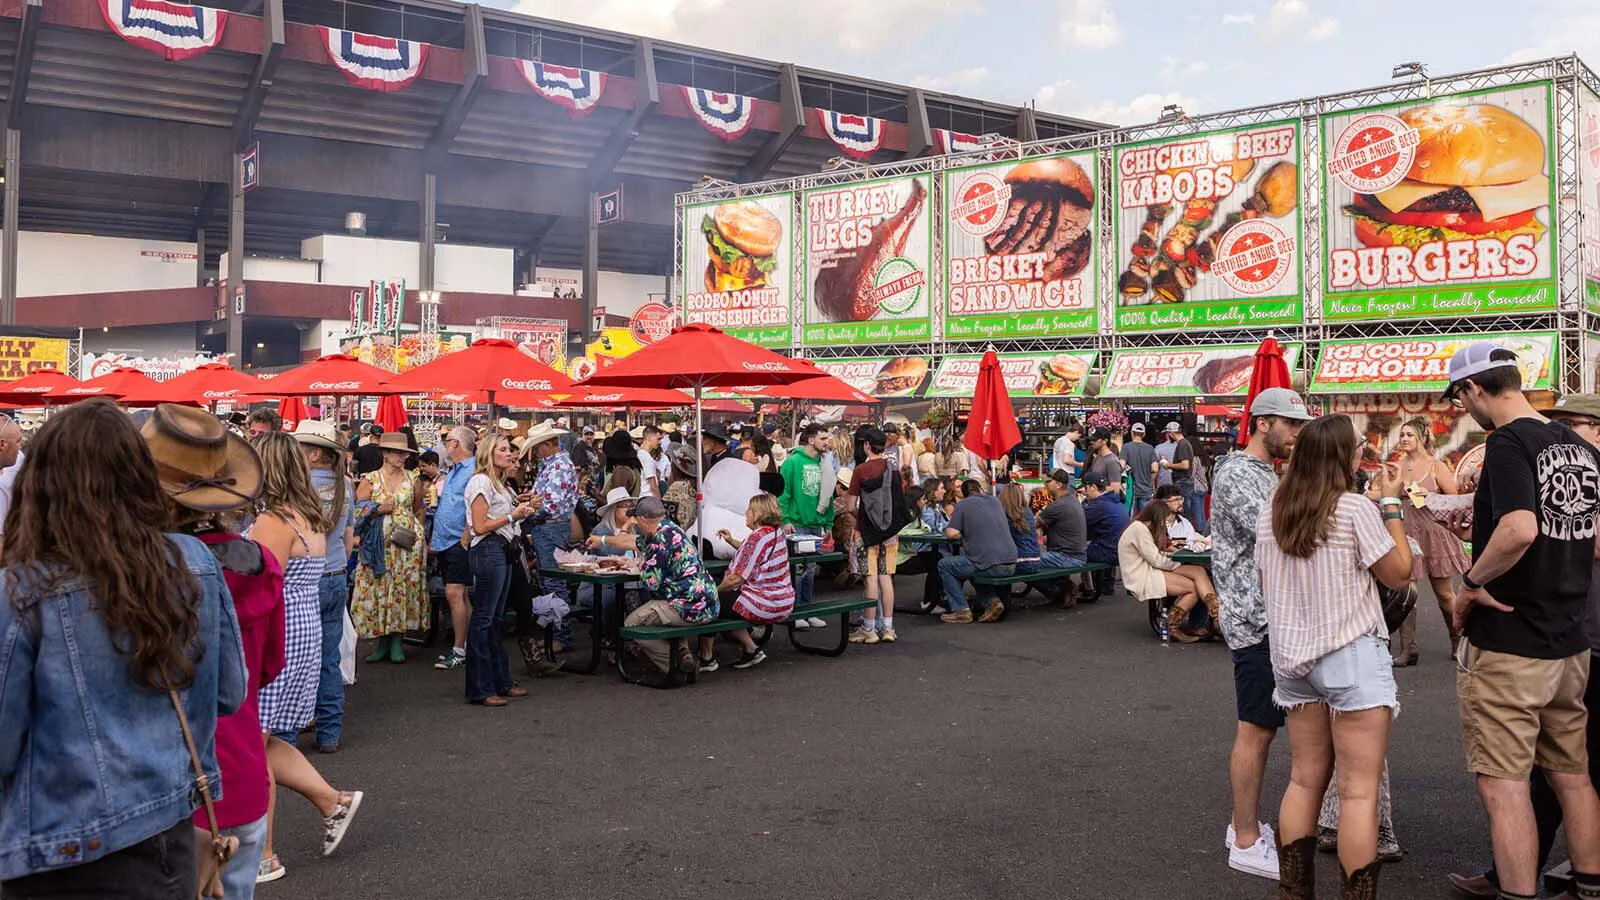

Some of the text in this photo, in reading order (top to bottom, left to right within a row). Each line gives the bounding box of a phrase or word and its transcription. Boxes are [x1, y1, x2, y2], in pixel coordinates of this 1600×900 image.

[1120, 141, 1209, 176] CHICKEN
[1237, 128, 1294, 160] BEEF
[1328, 129, 1420, 176] CERTIFIED ANGUS BEEF
[997, 185, 1012, 202] BEEF
[1121, 164, 1235, 209] KABOBS
[808, 187, 901, 222] TURKEY
[811, 217, 873, 251] LEGS
[950, 251, 1049, 285] BRISKET
[1212, 236, 1296, 277] CERTIFIED ANGUS BEEF
[1331, 234, 1538, 288] BURGERS
[688, 288, 779, 310] RODEO DONUT
[875, 273, 922, 300] ALWAYS FRESH
[950, 278, 1082, 313] SANDWICH
[1331, 301, 1363, 313] Never
[1367, 295, 1417, 316] Frozen!
[1432, 292, 1483, 312] Locally
[1487, 288, 1549, 307] Sourced!
[596, 316, 602, 330] 7
[687, 306, 789, 327] CHEESEBURGER
[949, 322, 972, 335] Never
[973, 319, 1007, 337] Frozen!
[1016, 317, 1050, 334] Locally
[1053, 315, 1093, 331] Sourced!
[1120, 311, 1147, 326] 100%
[1149, 309, 1195, 328] Quality!
[1206, 307, 1245, 325] Locally
[1249, 303, 1296, 321] Sourced!
[827, 327, 858, 343] Quality!
[866, 324, 893, 342] Locally
[895, 323, 927, 337] Sourced!
[1117, 352, 1203, 369] TURKEY
[1325, 341, 1437, 360] ICE COLD
[741, 361, 793, 372] Coca-Cola
[842, 362, 877, 378] PORK
[1112, 367, 1173, 387] LEGS
[309, 381, 363, 390] Coca-Cola
[501, 377, 553, 391] Coca-Cola
[1551, 471, 1597, 506] 805
[1541, 506, 1572, 541] STAY
